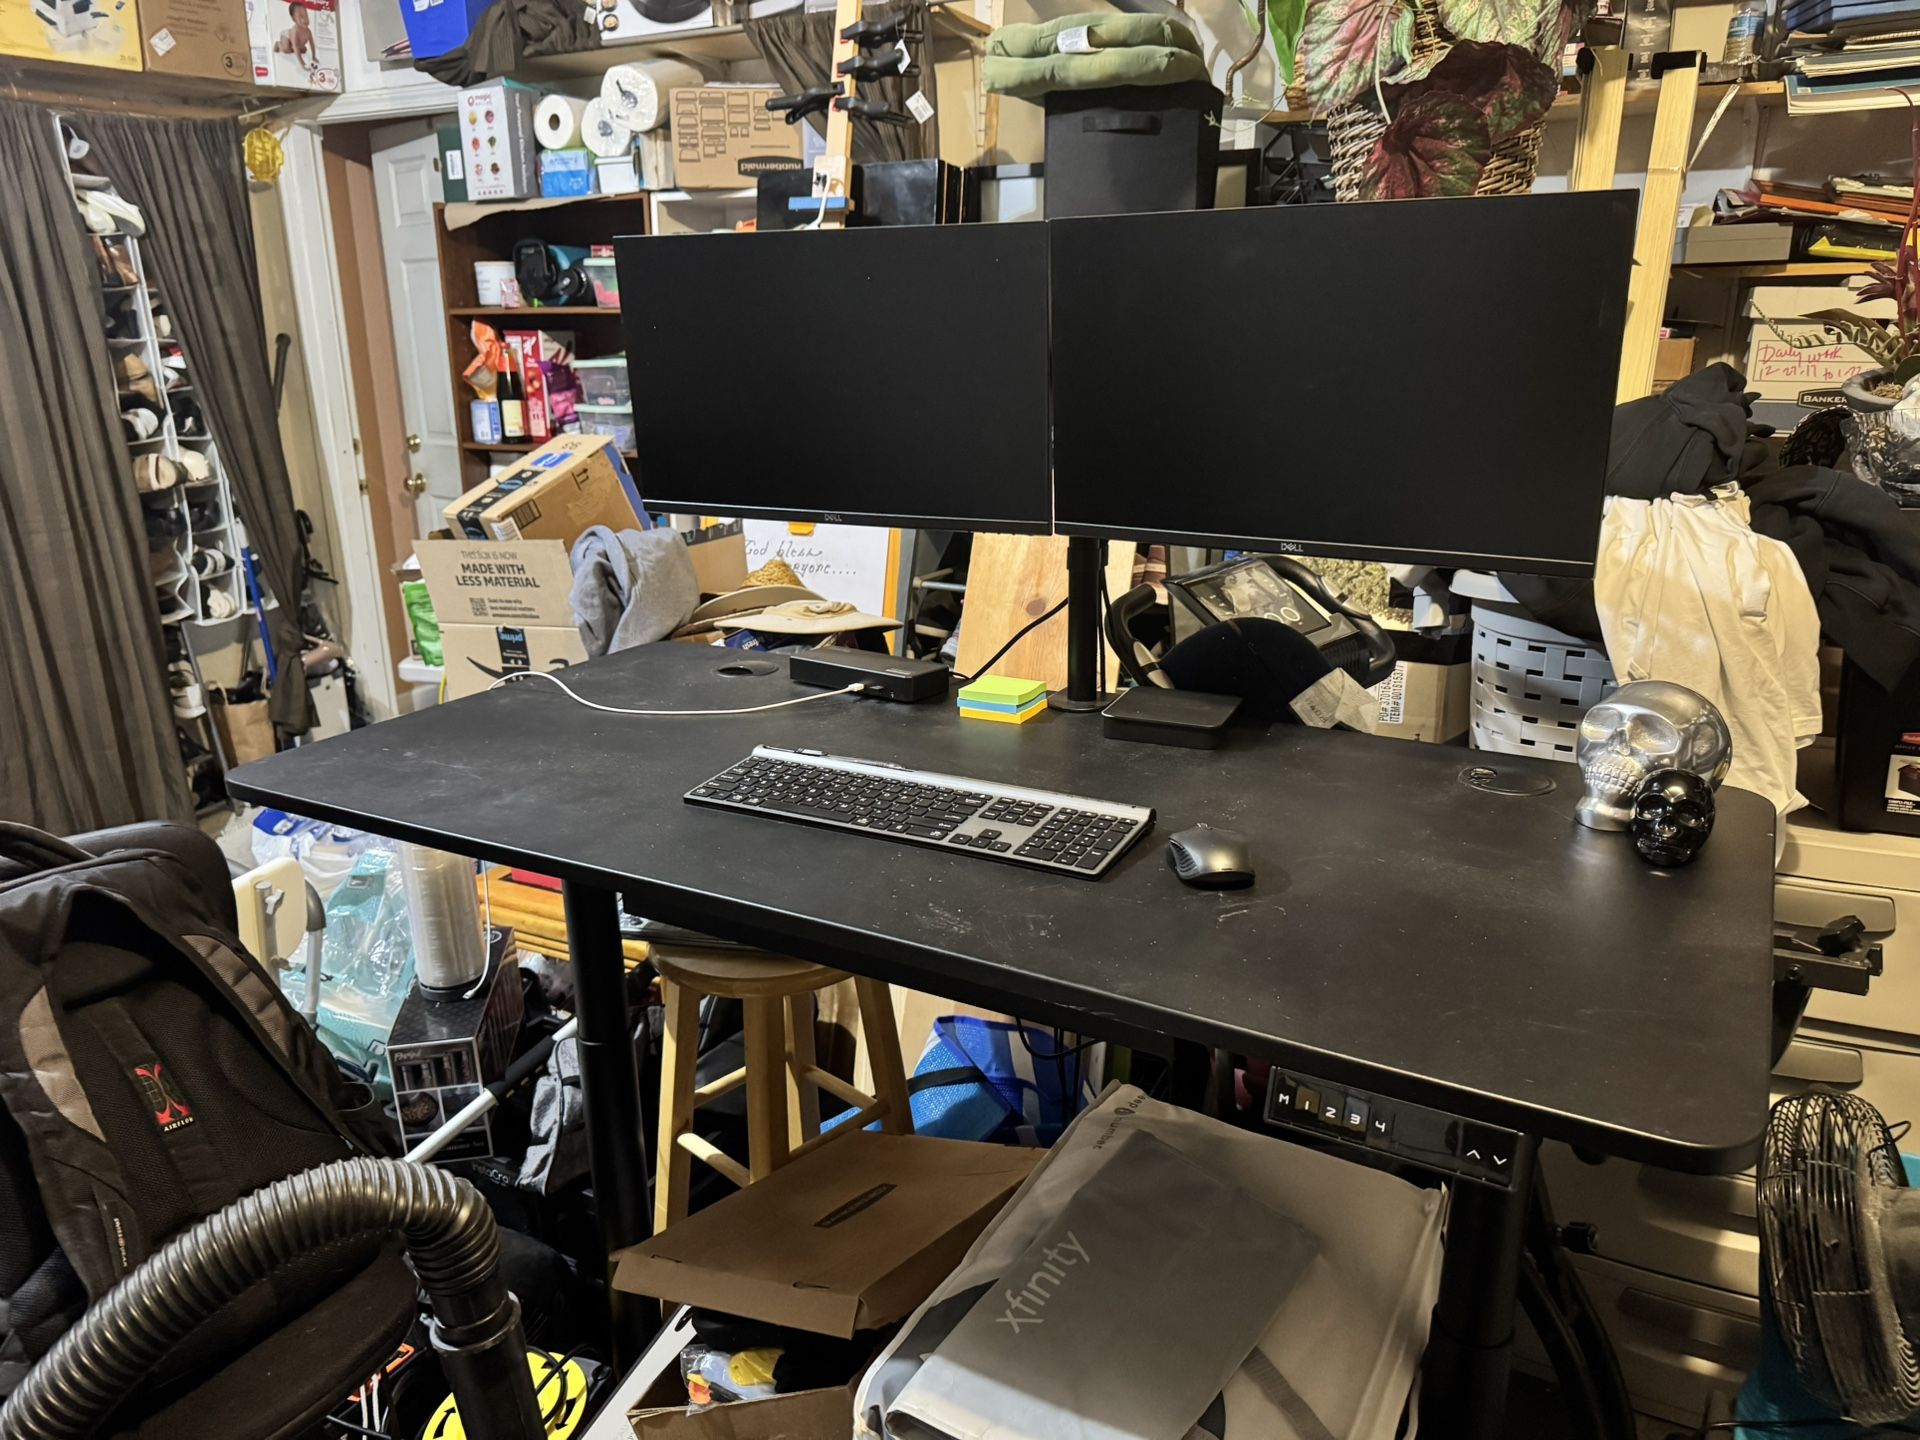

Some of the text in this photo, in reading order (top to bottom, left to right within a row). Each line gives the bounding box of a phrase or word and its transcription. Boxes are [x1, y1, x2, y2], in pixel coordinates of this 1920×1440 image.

[224, 56, 233, 69] 3
[318, 72, 327, 83] 3
[1759, 344, 1802, 368] Daily
[824, 513, 843, 522] DELL
[777, 540, 823, 558] bless
[1280, 542, 1304, 552] DELL
[499, 551, 518, 560] NOW
[461, 563, 526, 575] MADE WITH
[456, 576, 540, 588] LESS MATERIAL
[1278, 1093, 1386, 1133] M 1 2 3 4
[996, 1230, 1091, 1335] xfinity
